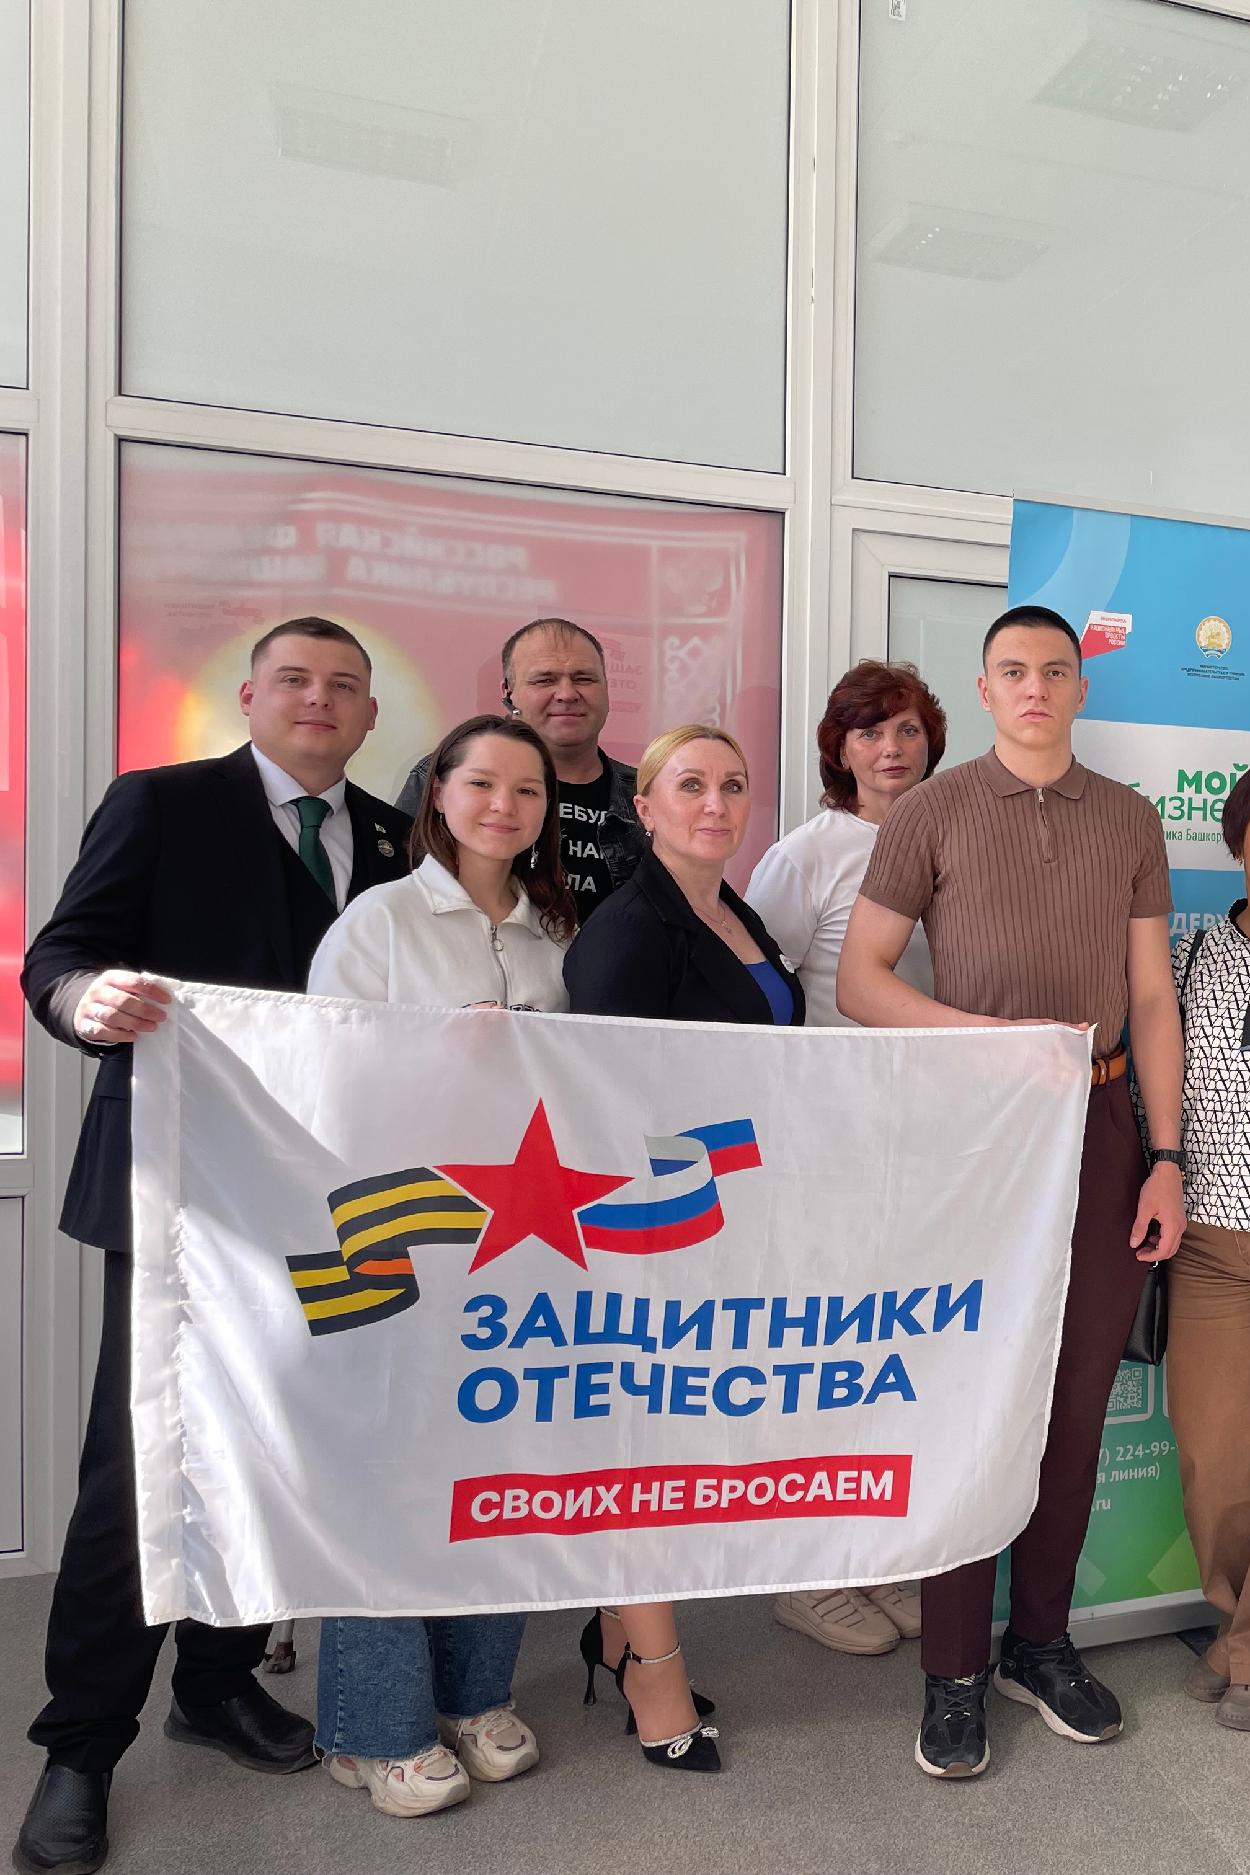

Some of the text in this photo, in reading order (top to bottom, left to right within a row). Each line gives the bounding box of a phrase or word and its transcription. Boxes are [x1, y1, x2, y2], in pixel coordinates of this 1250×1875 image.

[1186, 829, 1223, 844] Башкор
[569, 840, 605, 860] НА
[460, 1279, 983, 1353] ЗАЩИТНИКИ
[457, 1353, 917, 1424] ОТЕЧЕСТВА
[1115, 1441, 1178, 1462] 224-99-
[1109, 1462, 1160, 1482] линия)
[471, 1470, 894, 1523] СВОИХ НЕ БРОСАЕМ
